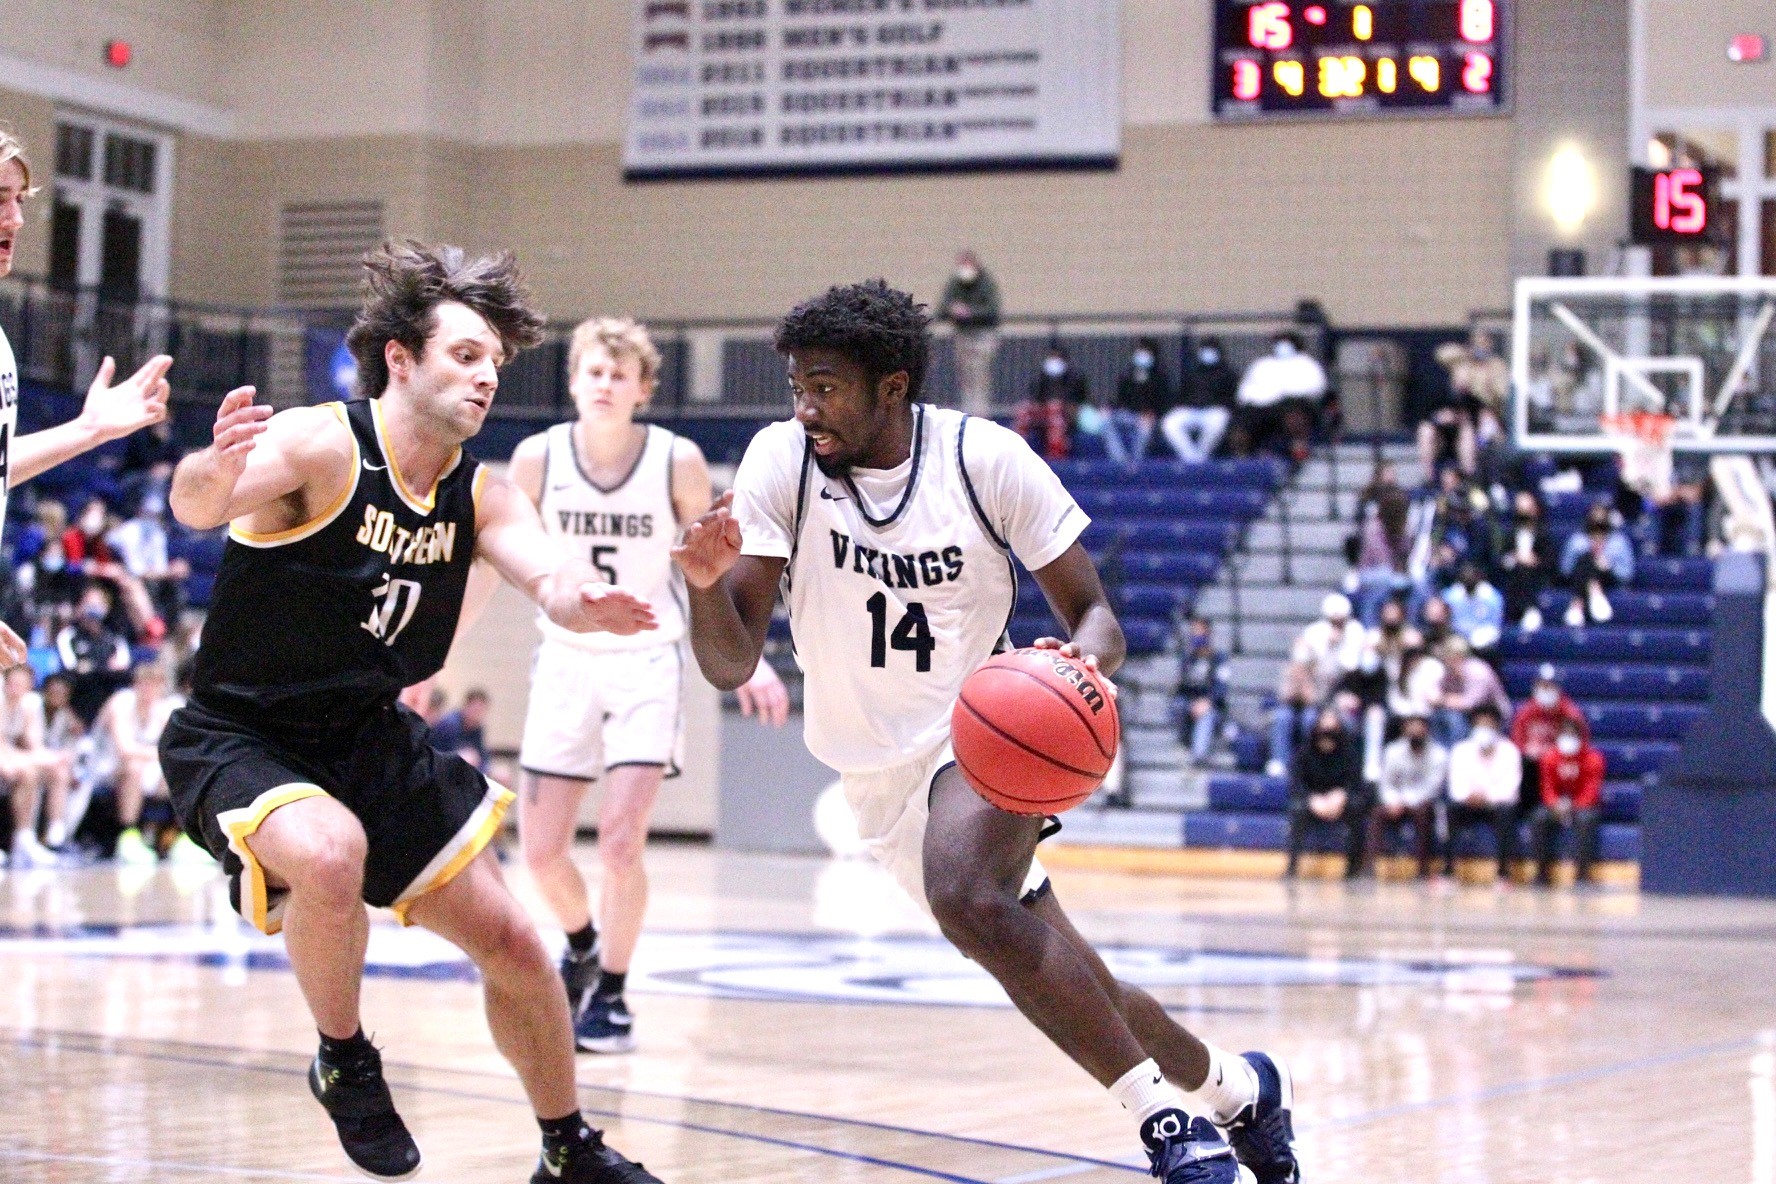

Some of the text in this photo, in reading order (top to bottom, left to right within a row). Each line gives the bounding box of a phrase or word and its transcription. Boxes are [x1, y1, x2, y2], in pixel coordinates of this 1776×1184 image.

[1377, 58, 1397, 93] 1
[1462, 51, 1492, 93] 2
[1654, 169, 1706, 233] 15
[356, 503, 457, 565] SOTHERN
[558, 510, 653, 538] VIKINGS
[591, 546, 618, 585] 5
[830, 528, 963, 589] VIKINGS
[866, 591, 935, 672] 14
